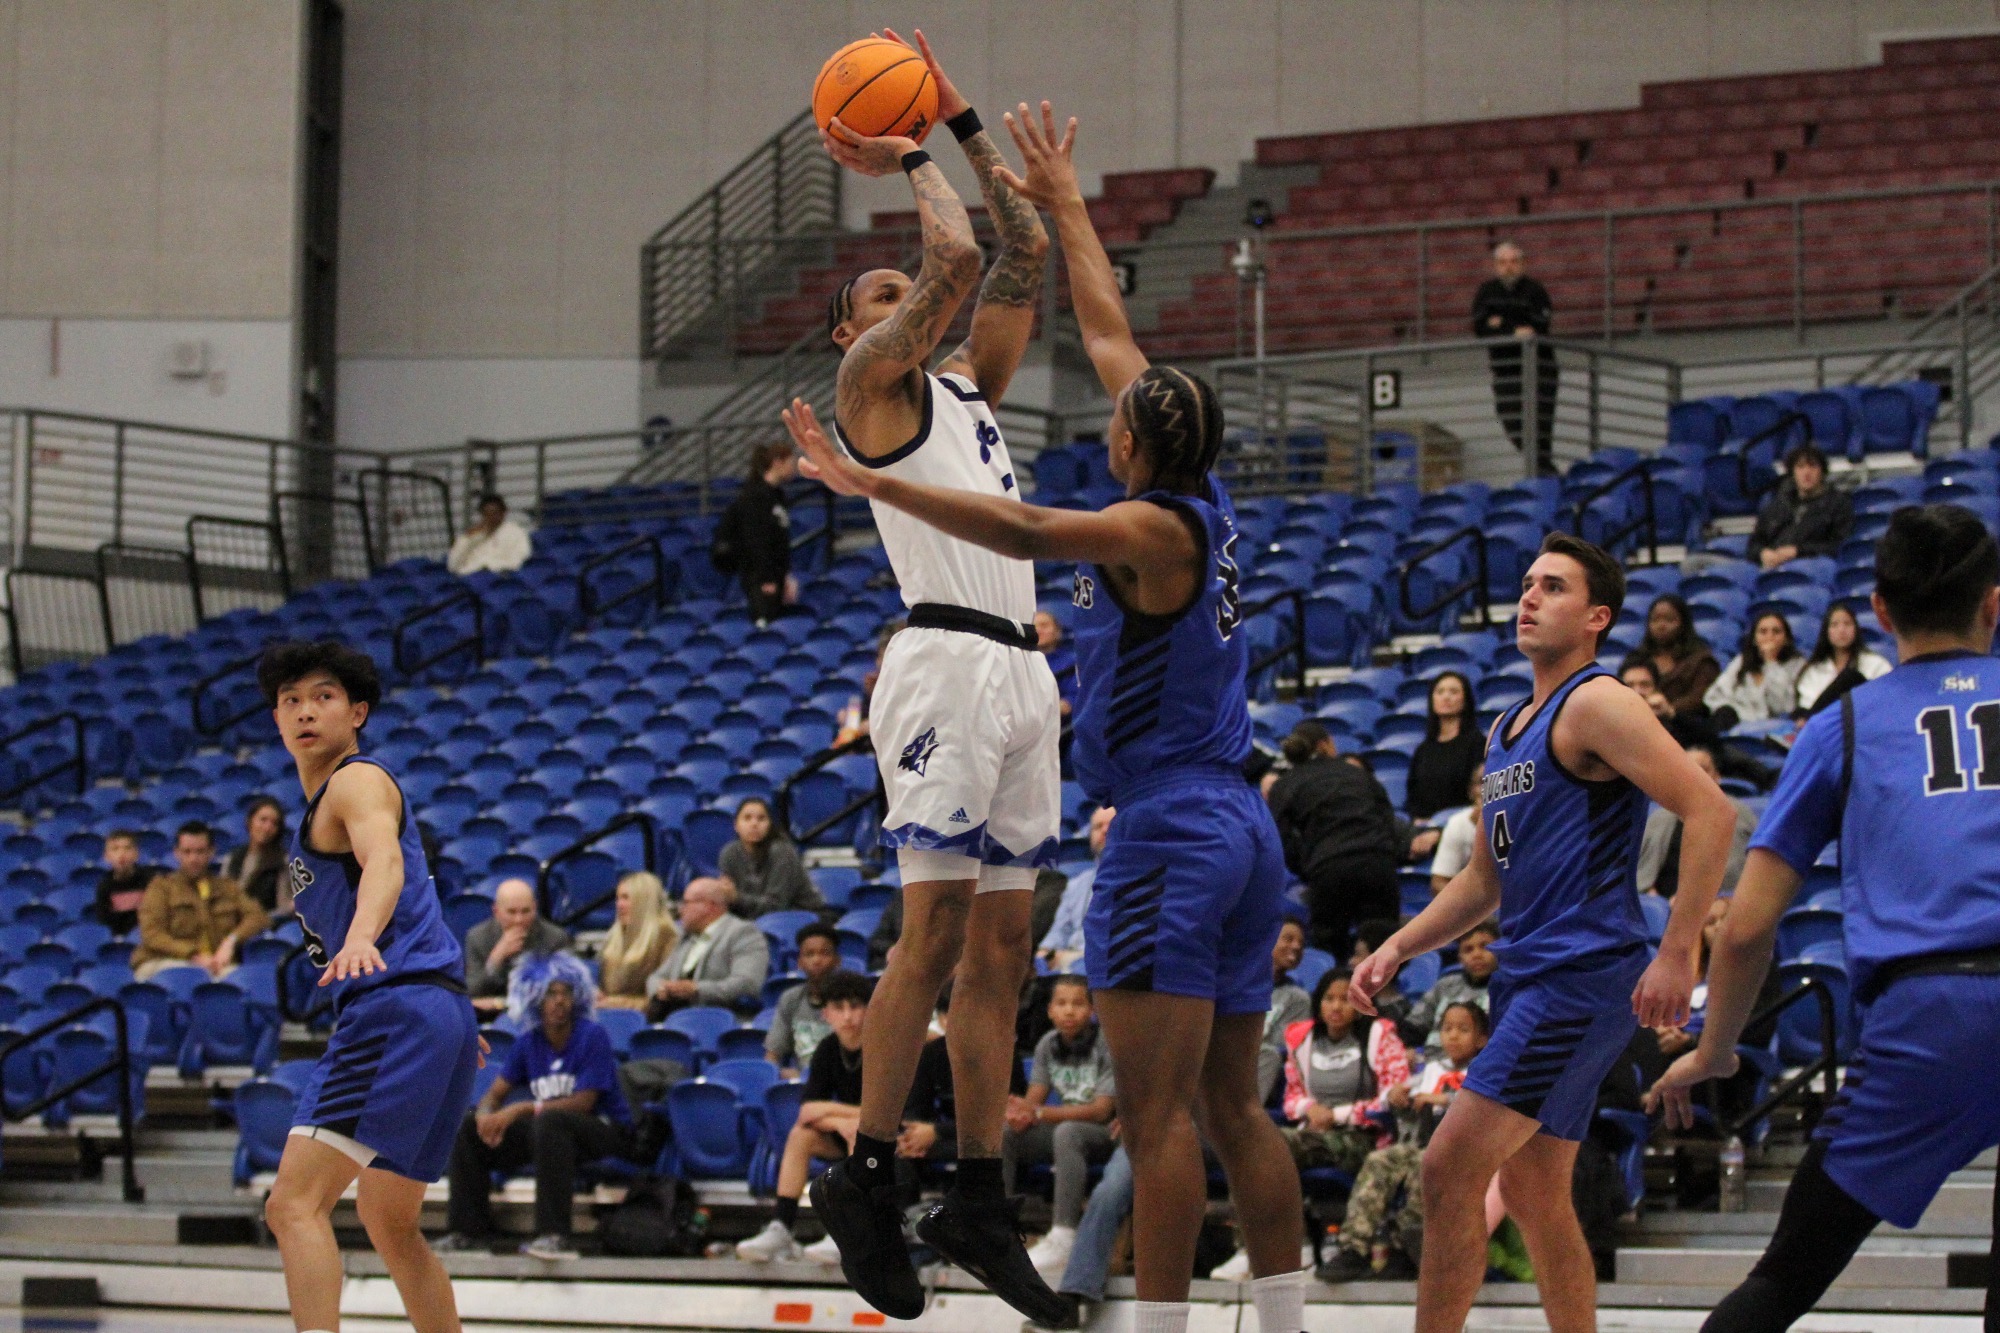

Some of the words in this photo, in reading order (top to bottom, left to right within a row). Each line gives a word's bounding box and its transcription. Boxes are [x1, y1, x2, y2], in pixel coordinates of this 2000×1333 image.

[1374, 375, 1395, 406] B
[1944, 676, 1976, 692] SM
[1915, 699, 2000, 797] 11
[1481, 760, 1535, 807] OUGARS
[948, 816, 970, 824] adidas
[1491, 809, 1514, 870] 4
